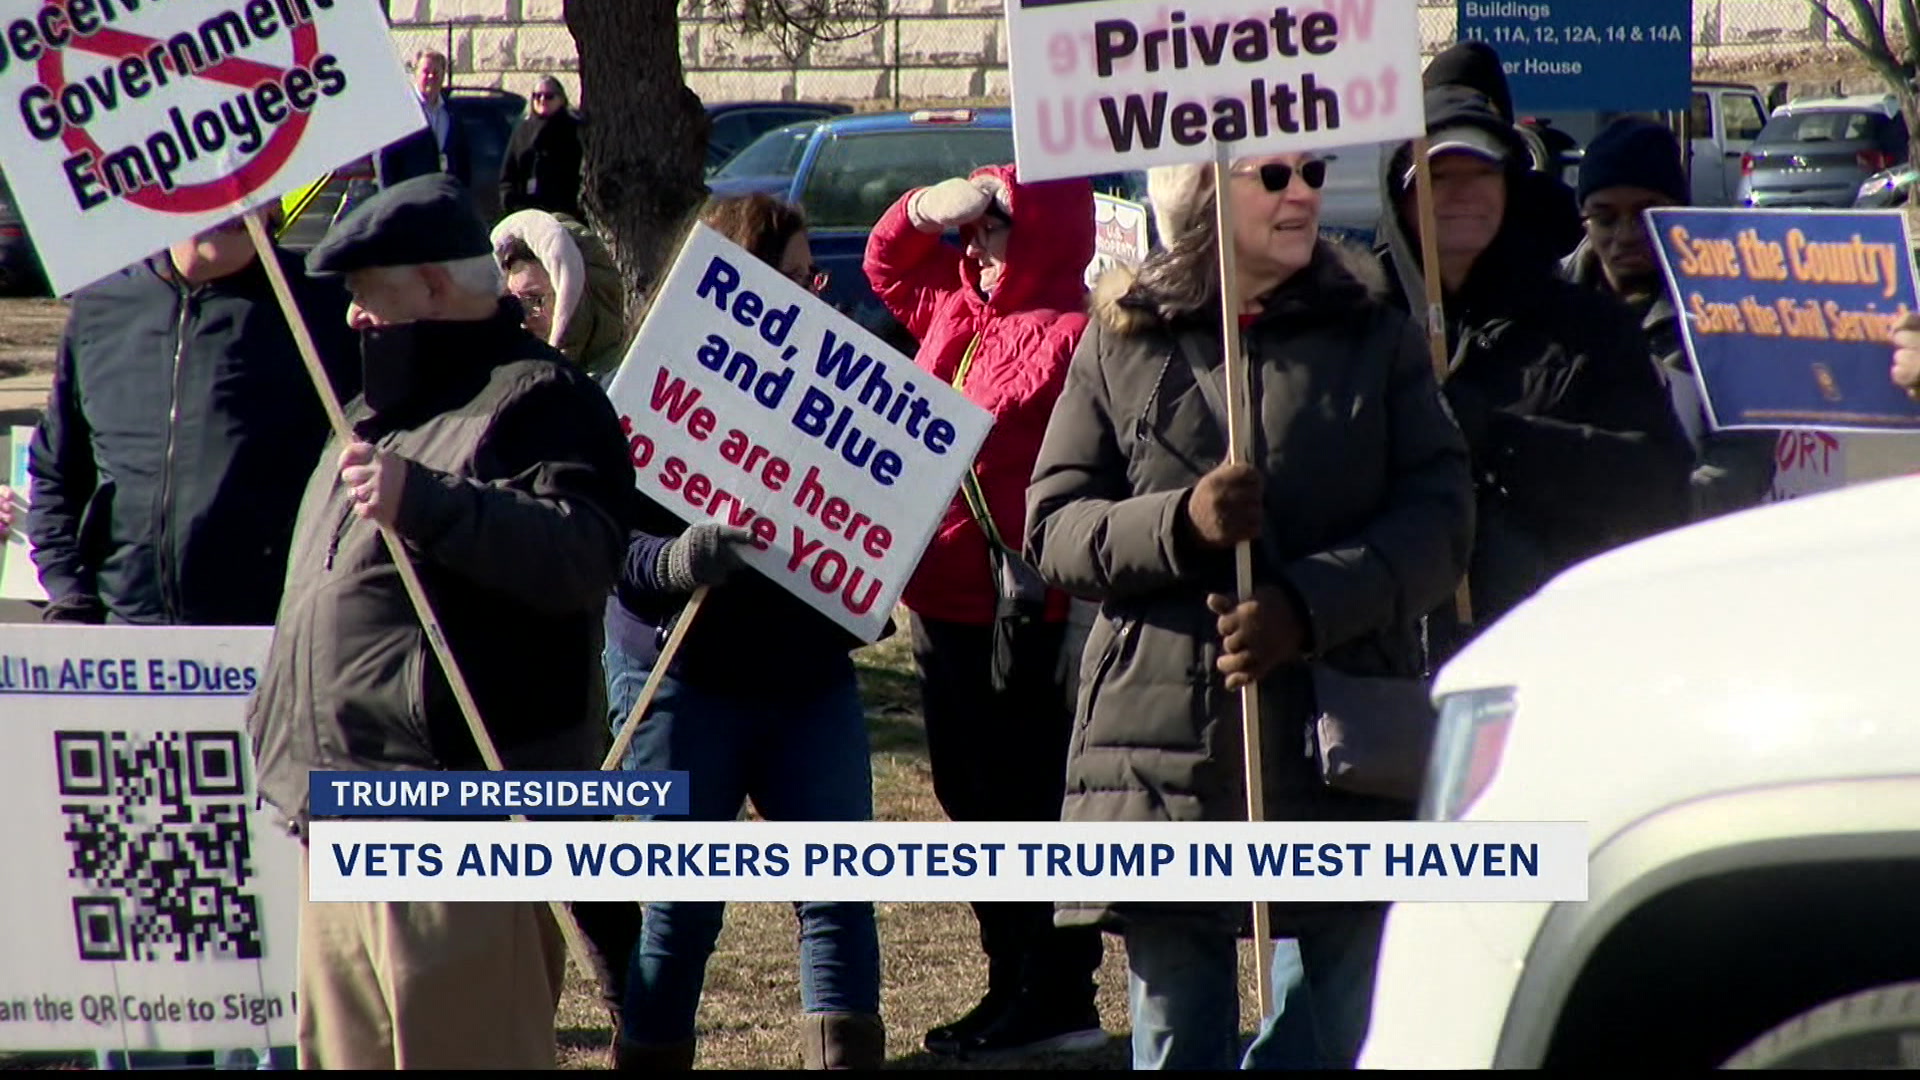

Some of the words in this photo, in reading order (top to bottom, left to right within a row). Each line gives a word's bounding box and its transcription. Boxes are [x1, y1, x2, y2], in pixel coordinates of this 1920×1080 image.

[1095, 7, 1338, 77] Private
[1466, 2, 1550, 21] Buildings
[1466, 27, 1489, 43] 11,
[1494, 27, 1530, 43] 11A,
[1535, 27, 1559, 43] 12,
[1564, 27, 1601, 43] 12A,
[1606, 27, 1625, 42] 14
[1630, 26, 1643, 42] &
[1649, 27, 1682, 42] 14A
[20, 0, 334, 140] Governmen
[1525, 58, 1582, 74] House
[63, 54, 346, 211] Employees
[1100, 73, 1339, 153] Wealth
[1670, 225, 1740, 278] Save
[1738, 228, 1787, 281] the
[1786, 228, 1897, 297] Country
[1690, 293, 1745, 334] Save
[1741, 295, 1781, 334] the
[1777, 297, 1829, 338] Civil
[696, 256, 800, 361] Red,
[815, 329, 956, 454] White
[697, 333, 795, 409] and
[791, 386, 903, 486] Blue
[649, 366, 717, 441] We
[719, 429, 790, 491] are
[793, 466, 892, 558] here
[658, 456, 777, 551] serve
[787, 525, 883, 616] YOU
[21, 657, 49, 689] In
[59, 658, 138, 690] AFGE
[148, 659, 257, 690] E-Dues
[34, 994, 73, 1021] the
[80, 995, 117, 1026] QR
[122, 994, 182, 1021] Code
[188, 997, 215, 1021] to
[223, 993, 283, 1026] Sign
